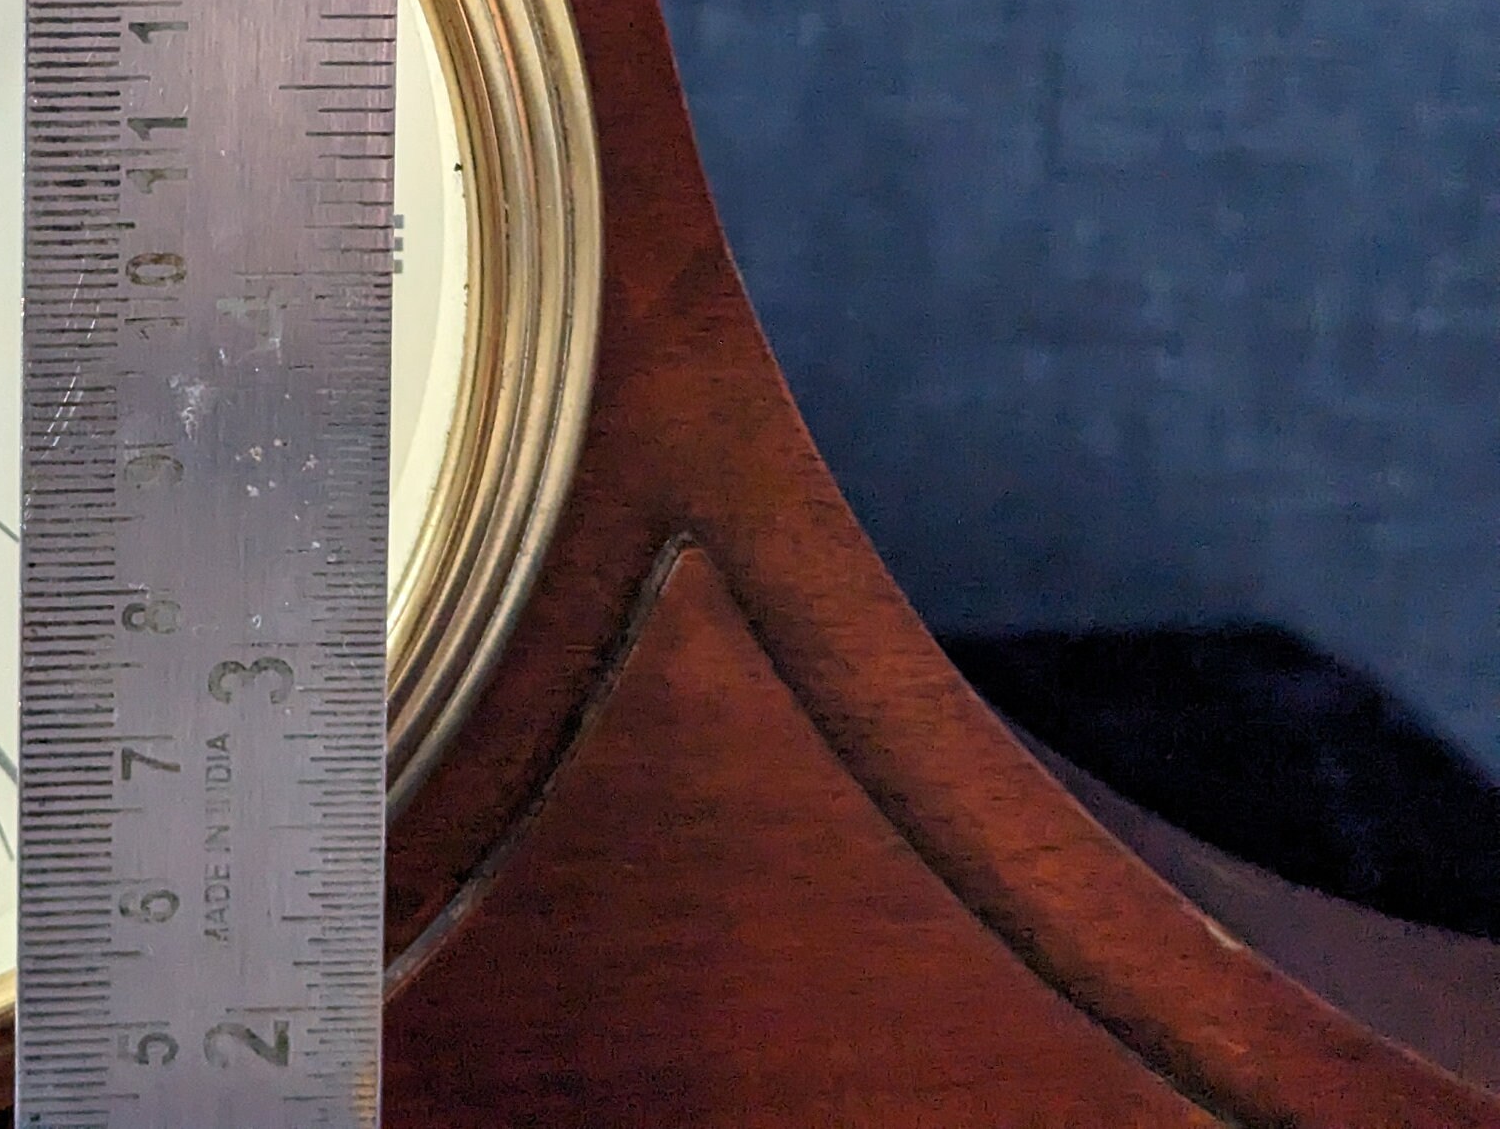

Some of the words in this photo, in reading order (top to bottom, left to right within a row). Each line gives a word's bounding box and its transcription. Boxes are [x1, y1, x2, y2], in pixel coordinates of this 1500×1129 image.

[126, 117, 188, 194] 11
[125, 252, 187, 340] 10
[121, 600, 181, 634] 8
[208, 656, 294, 704] 3
[121, 747, 181, 781] 7
[119, 888, 181, 924] 6
[204, 863, 232, 945] MADE
[116, 1031, 180, 1067] 5
[203, 1019, 290, 1069] 2
